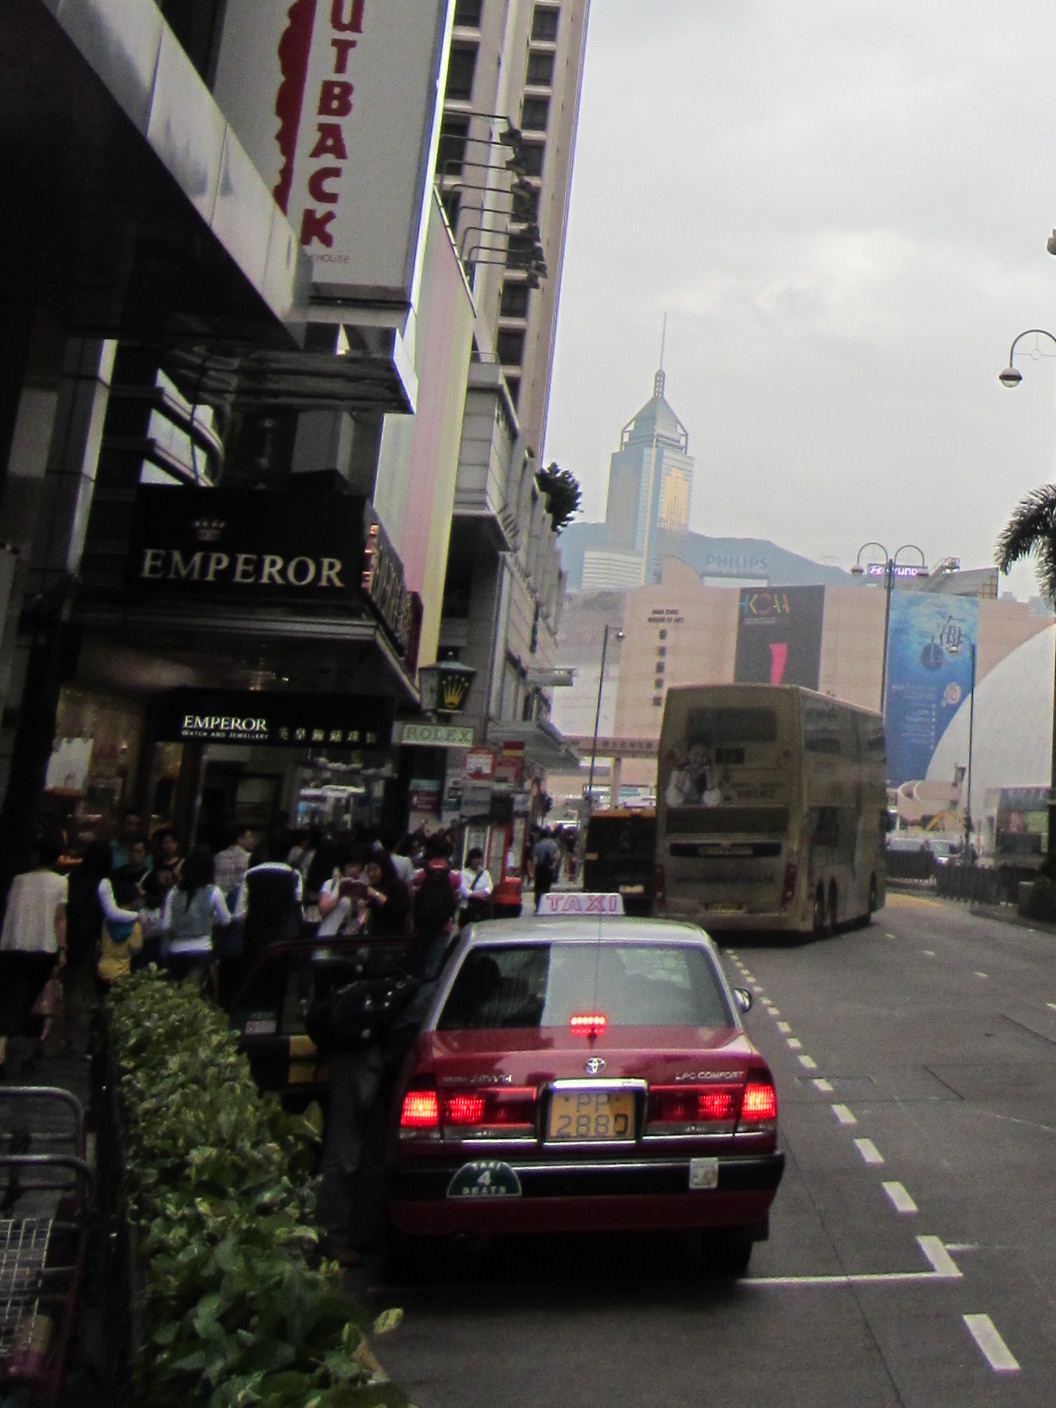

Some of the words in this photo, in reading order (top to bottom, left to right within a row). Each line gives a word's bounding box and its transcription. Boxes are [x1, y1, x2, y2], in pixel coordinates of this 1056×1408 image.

[140, 547, 346, 588] EMPEROR
[705, 554, 768, 570] PHILIPS
[182, 714, 269, 732] EMPEROR
[404, 725, 473, 743] ROLEX
[546, 894, 618, 912] TAXI
[697, 1070, 745, 1080] COMFORT
[576, 1093, 610, 1113] PP
[556, 1114, 629, 1136] 2880
[476, 1169, 492, 1187] 4
[462, 1185, 507, 1196] SEATS
